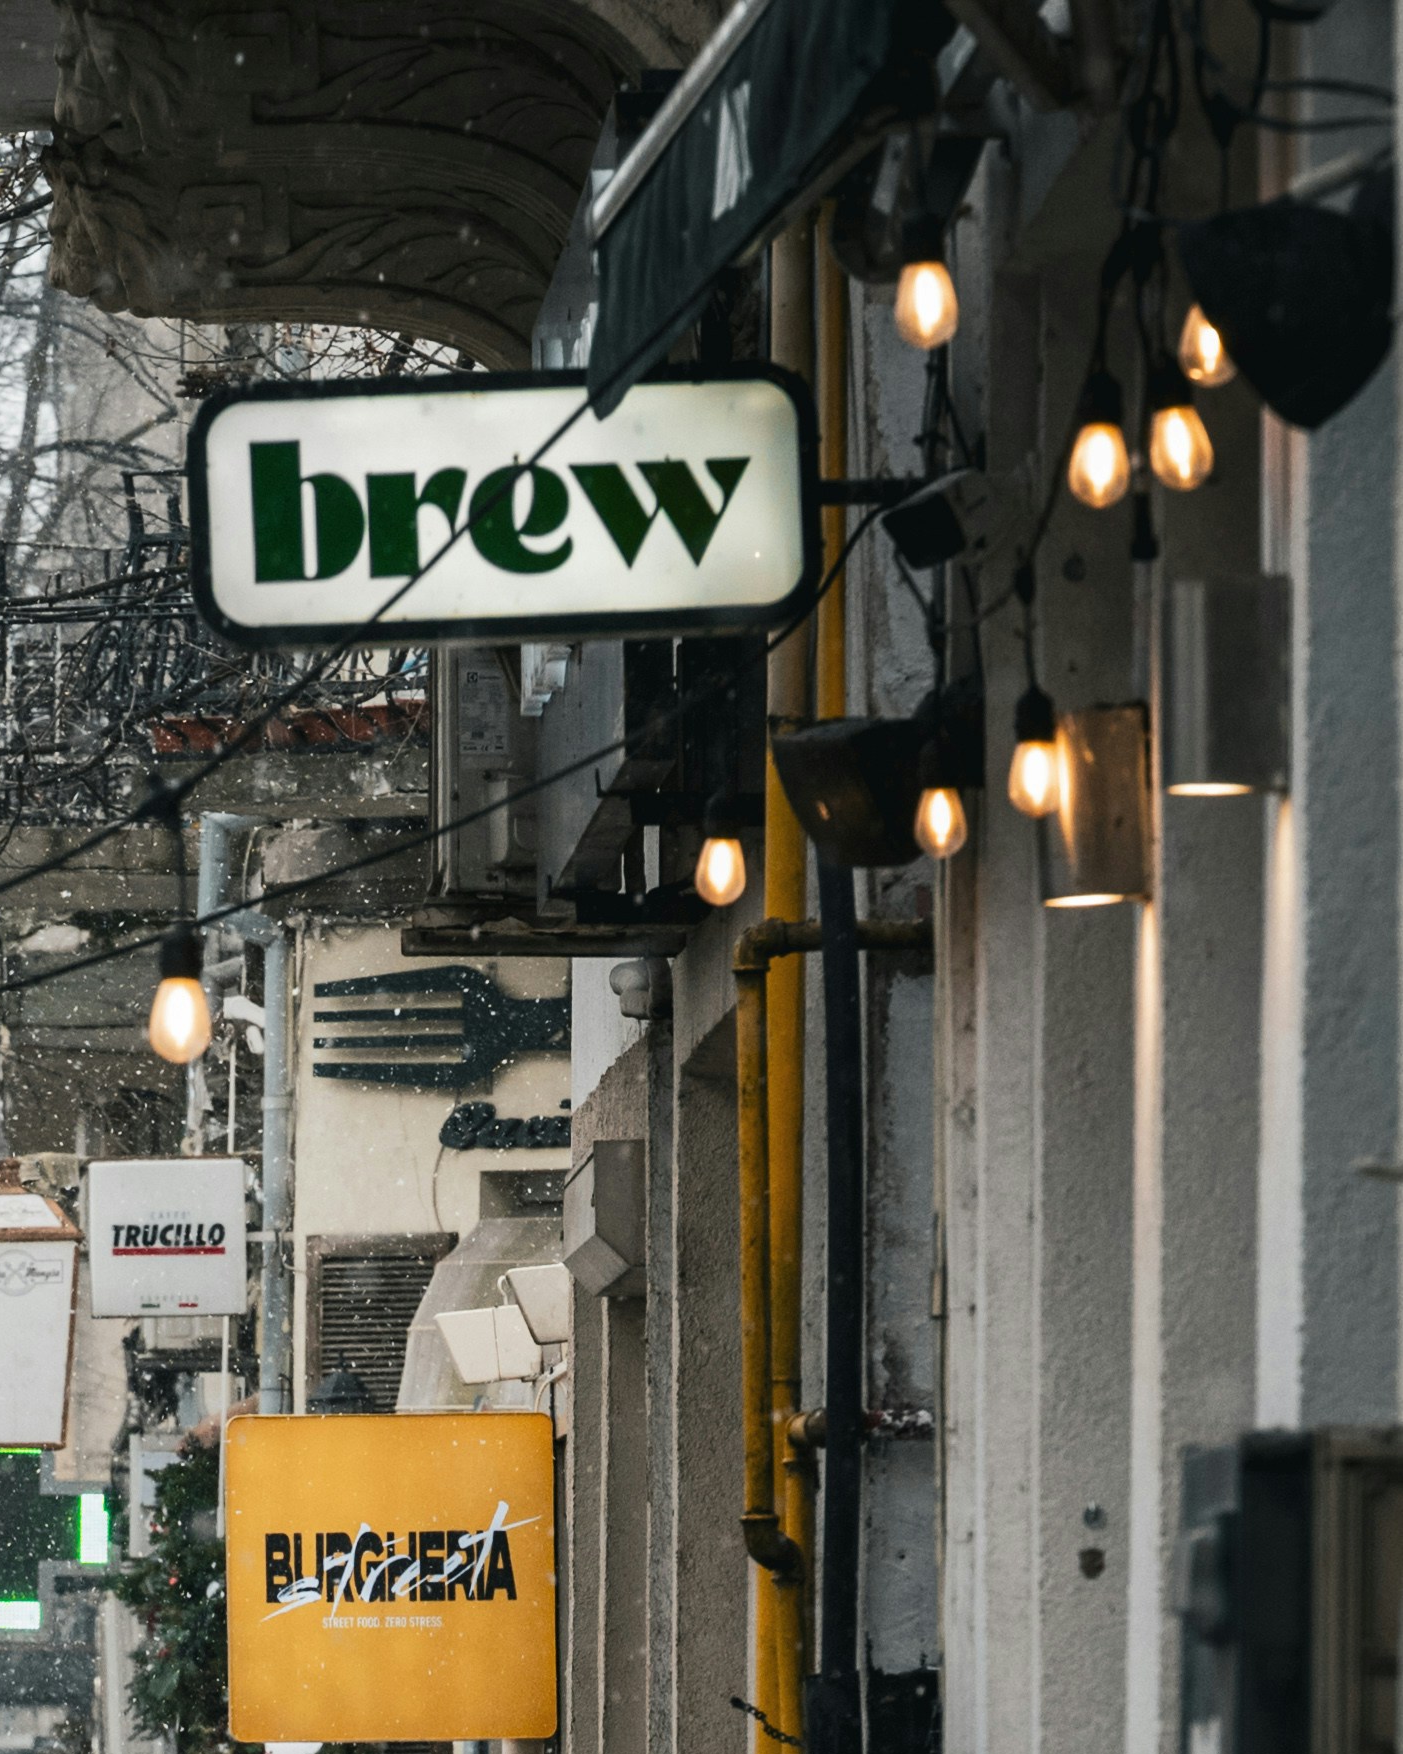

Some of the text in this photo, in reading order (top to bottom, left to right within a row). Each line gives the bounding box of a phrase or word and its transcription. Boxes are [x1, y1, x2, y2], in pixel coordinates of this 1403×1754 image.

[250, 441, 751, 583] brew
[112, 1223, 226, 1247] TRUCILLO
[265, 1531, 517, 1603] BURGHERIA
[322, 1616, 355, 1629] STREET
[385, 1616, 407, 1628] ZERO
